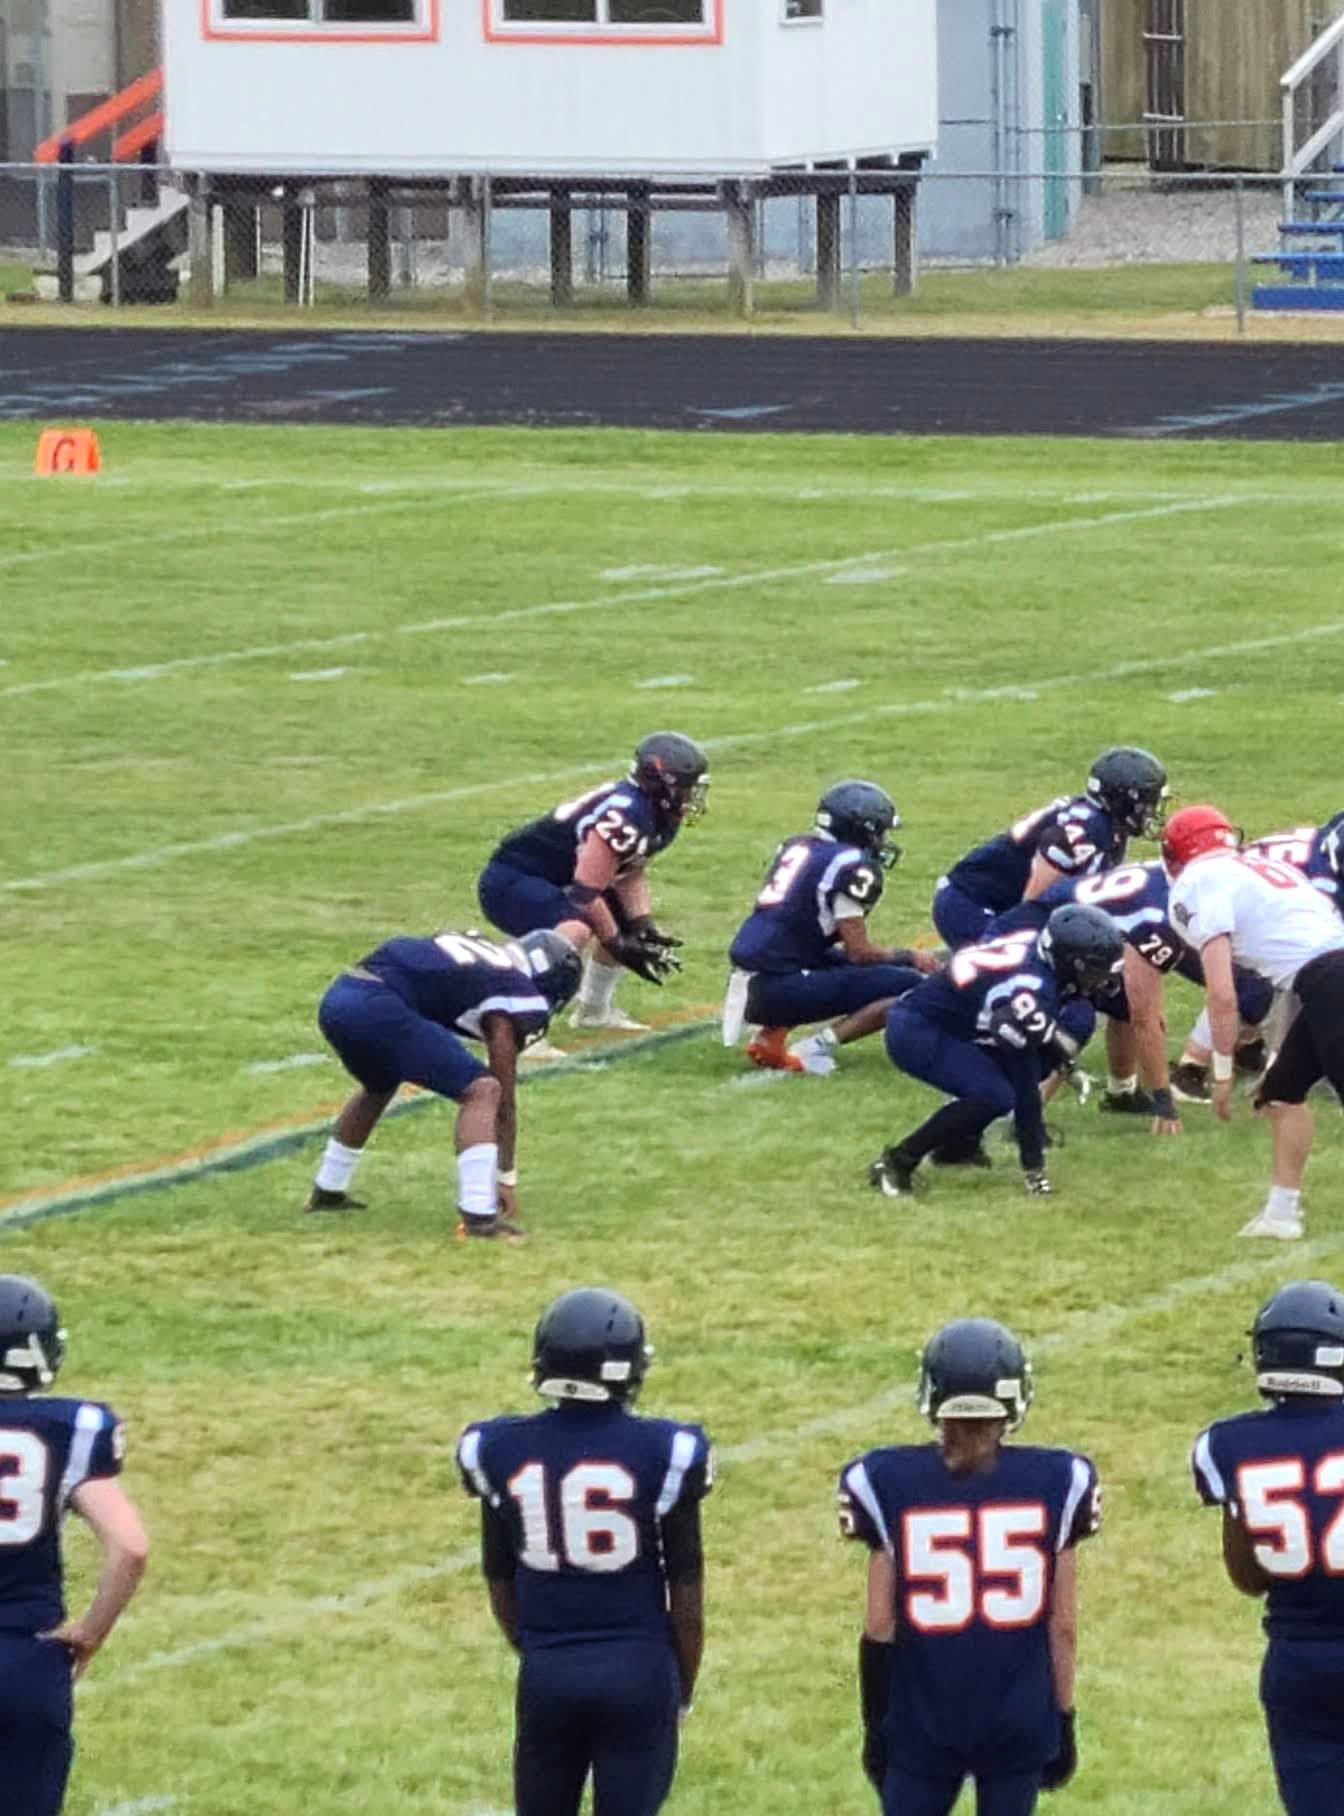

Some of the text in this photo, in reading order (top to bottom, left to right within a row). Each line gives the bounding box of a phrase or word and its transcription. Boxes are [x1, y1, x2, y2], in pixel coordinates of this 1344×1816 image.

[51, 437, 76, 473] G
[595, 809, 638, 852] 23
[849, 868, 874, 898] 3
[1139, 933, 1173, 966] 79
[1011, 990, 1047, 1031] 92
[507, 1460, 640, 1573] 16
[902, 1500, 1047, 1634] 55
